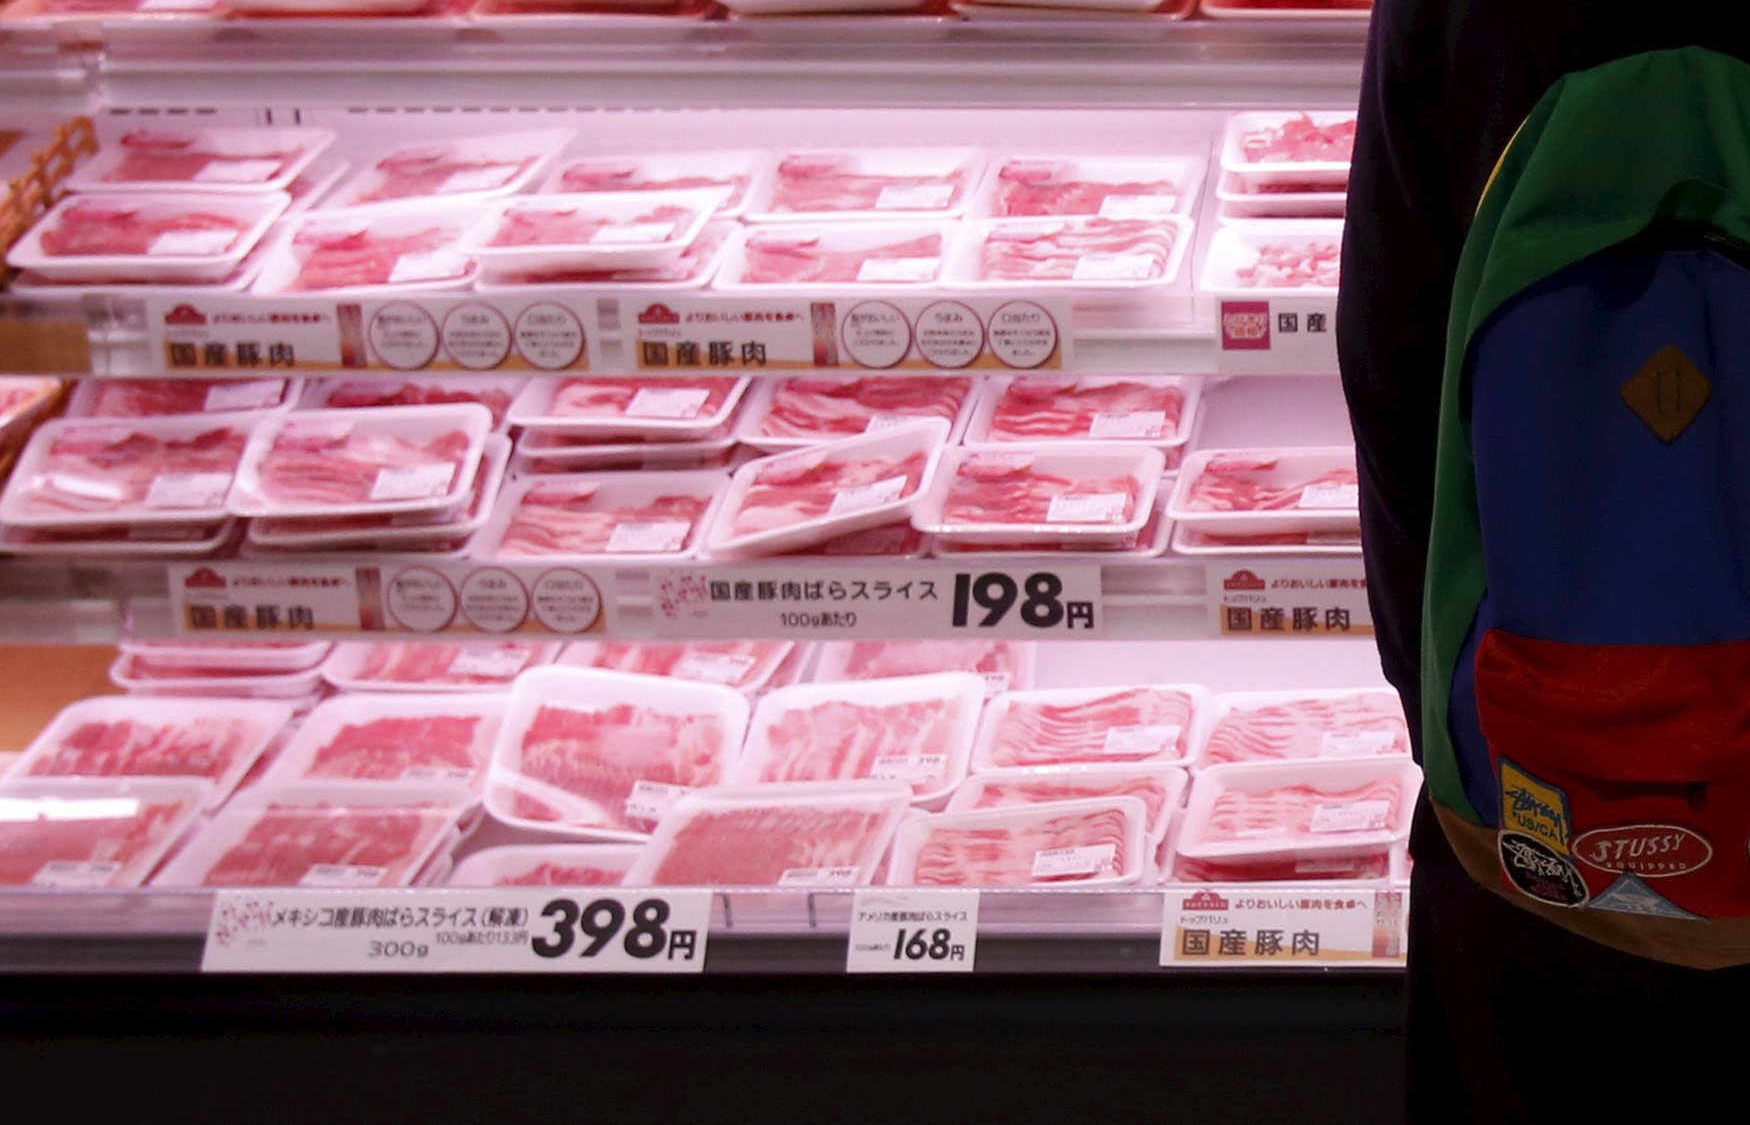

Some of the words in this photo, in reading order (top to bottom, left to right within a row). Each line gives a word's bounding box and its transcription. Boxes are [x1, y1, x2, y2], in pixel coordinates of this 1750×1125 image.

[1278, 312, 1328, 334] 国産
[170, 341, 295, 367] 国産豚肉
[643, 340, 768, 366] 国産豚肉
[709, 579, 938, 602] 国産豚肉ばらスライス
[951, 571, 1095, 630] 198円
[190, 604, 314, 630] 国産豚肉
[780, 612, 857, 629] 100gあたり
[1228, 607, 1351, 631] 国産豚肉
[1589, 833, 1686, 863] STUSSY
[1235, 899, 1368, 911] よりおいしい豚肉を食卓へ
[531, 898, 697, 960] 398円
[368, 940, 430, 958] 300g
[892, 927, 966, 962] 168円
[1183, 929, 1321, 956] 国産豚肉
